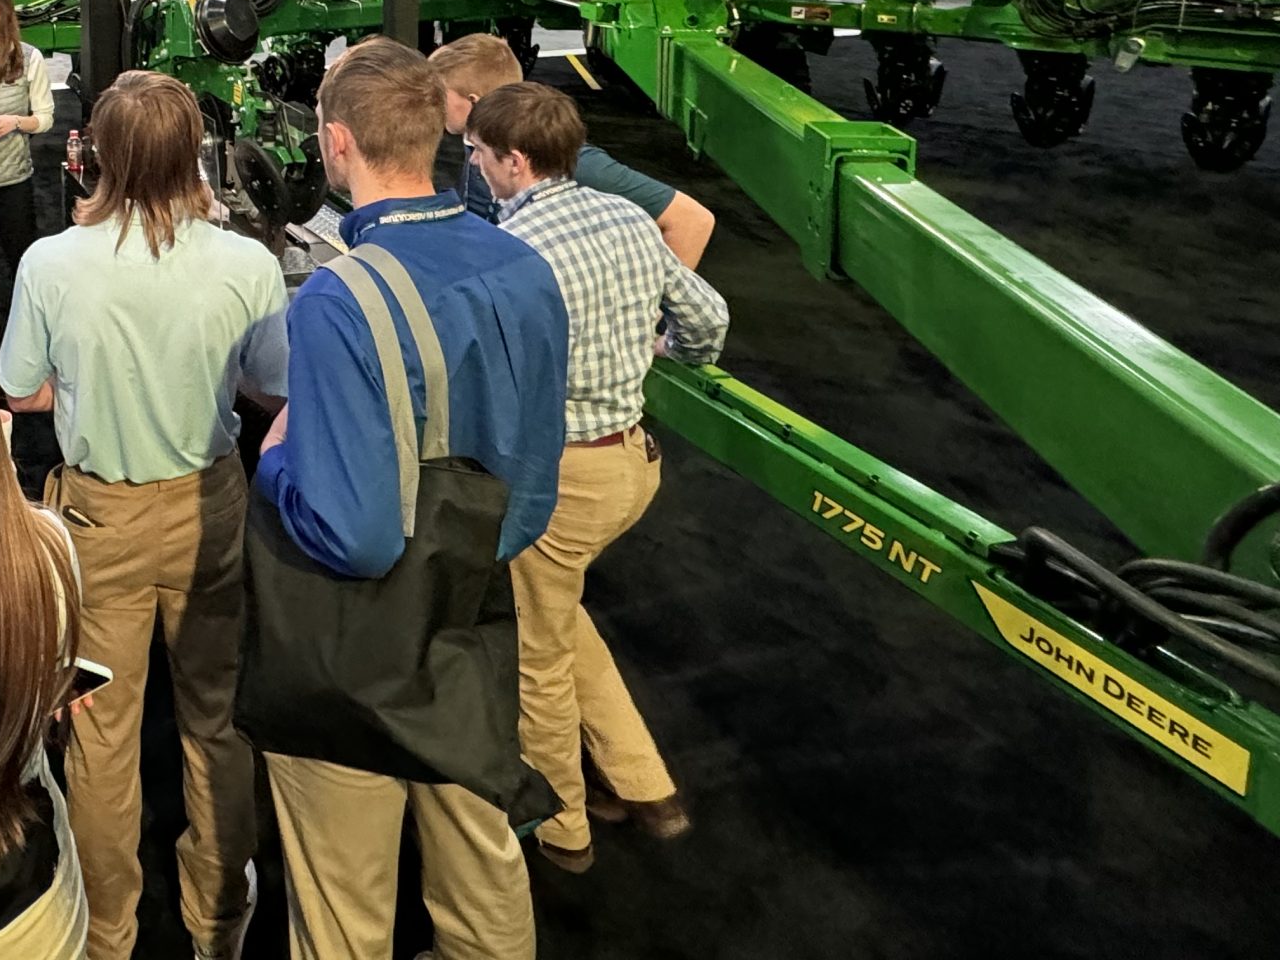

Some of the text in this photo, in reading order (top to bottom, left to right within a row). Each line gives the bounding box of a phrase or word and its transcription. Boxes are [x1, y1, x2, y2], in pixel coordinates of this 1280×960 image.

[812, 490, 942, 584] 1775 NT
[1019, 627, 1213, 760] JOHN DEERE
